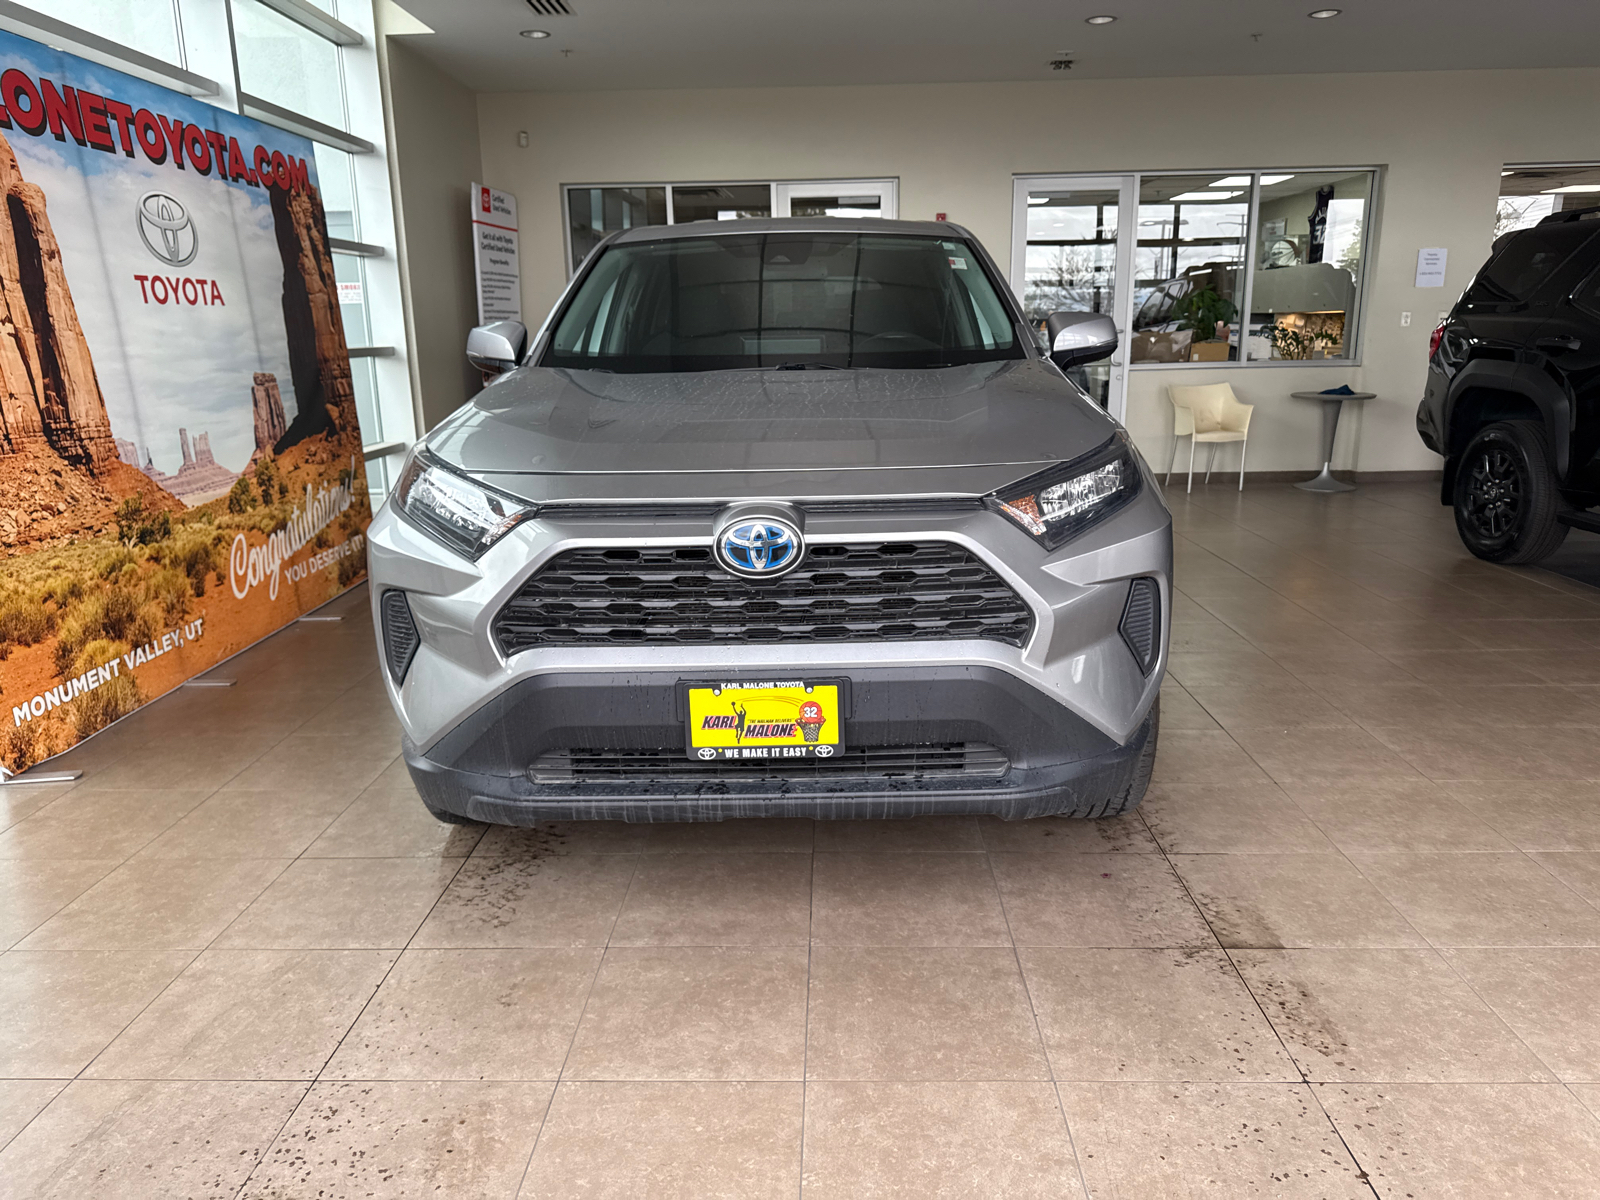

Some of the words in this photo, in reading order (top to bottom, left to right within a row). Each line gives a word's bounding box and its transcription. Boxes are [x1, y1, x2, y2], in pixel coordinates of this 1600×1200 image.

[134, 274, 225, 306] TOYOTA
[230, 454, 356, 601] Congratulations!
[284, 560, 309, 585] YOU
[308, 541, 351, 574] DESERVE
[350, 533, 365, 552] IT!
[12, 657, 120, 728] MONUMENT
[123, 629, 184, 670] VALLEY,
[184, 618, 204, 641] UT
[720, 682, 741, 690] KARL
[775, 681, 805, 689] TOYOTA
[803, 706, 818, 718] 32
[701, 715, 738, 730] KARL
[743, 723, 798, 739] MALONE
[725, 748, 739, 758] WE
[742, 748, 768, 757] MAKE
[771, 748, 780, 757] IT
[783, 747, 807, 757] EASY
